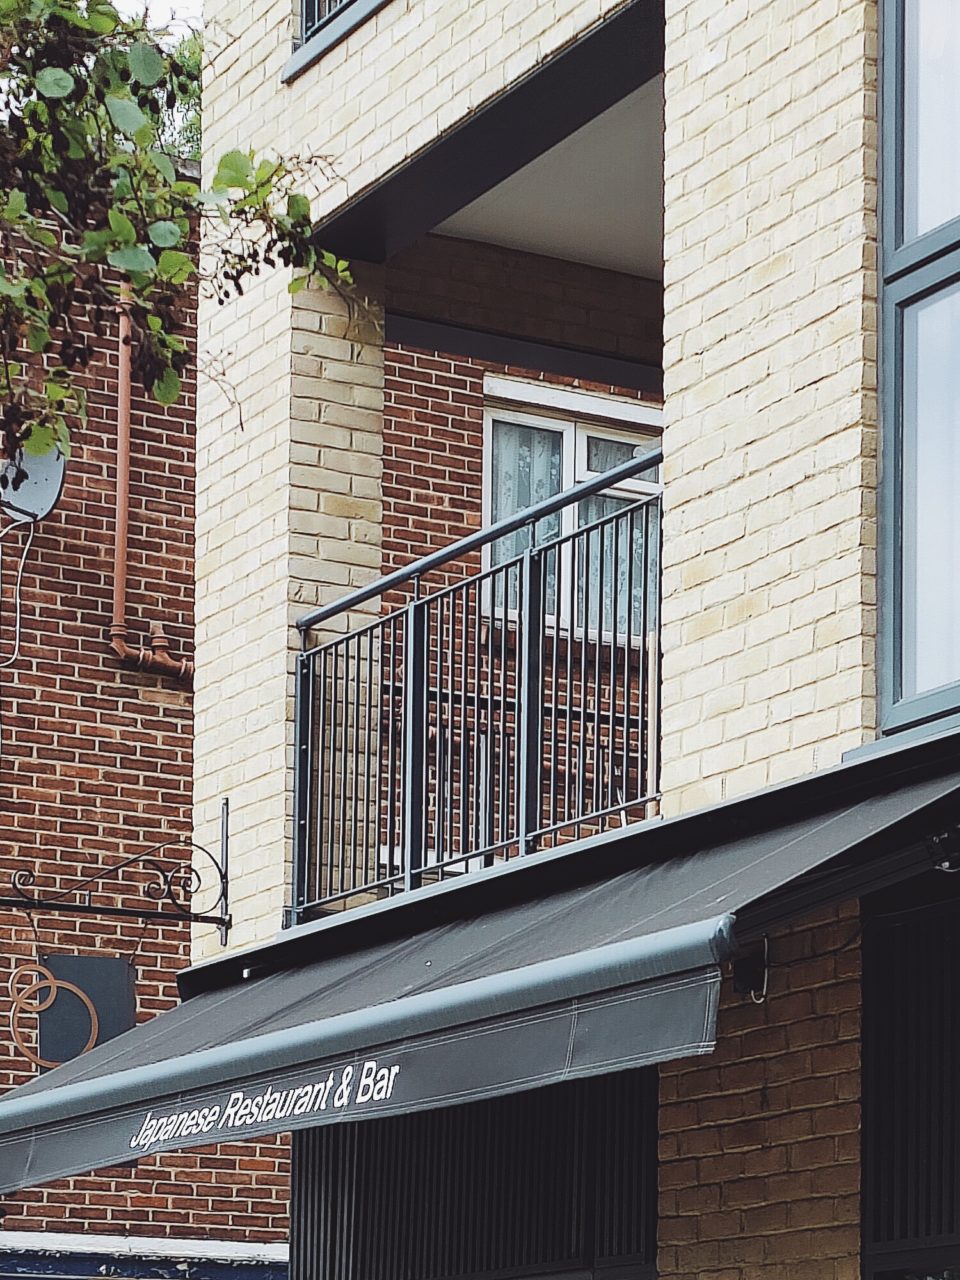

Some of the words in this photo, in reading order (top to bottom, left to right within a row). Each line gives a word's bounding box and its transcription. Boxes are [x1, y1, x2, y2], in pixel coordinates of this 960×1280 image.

[129, 1105, 221, 1151] Japanese
[217, 1070, 335, 1129] Restaurant
[332, 1065, 353, 1109] &
[355, 1060, 401, 1105] Bar
